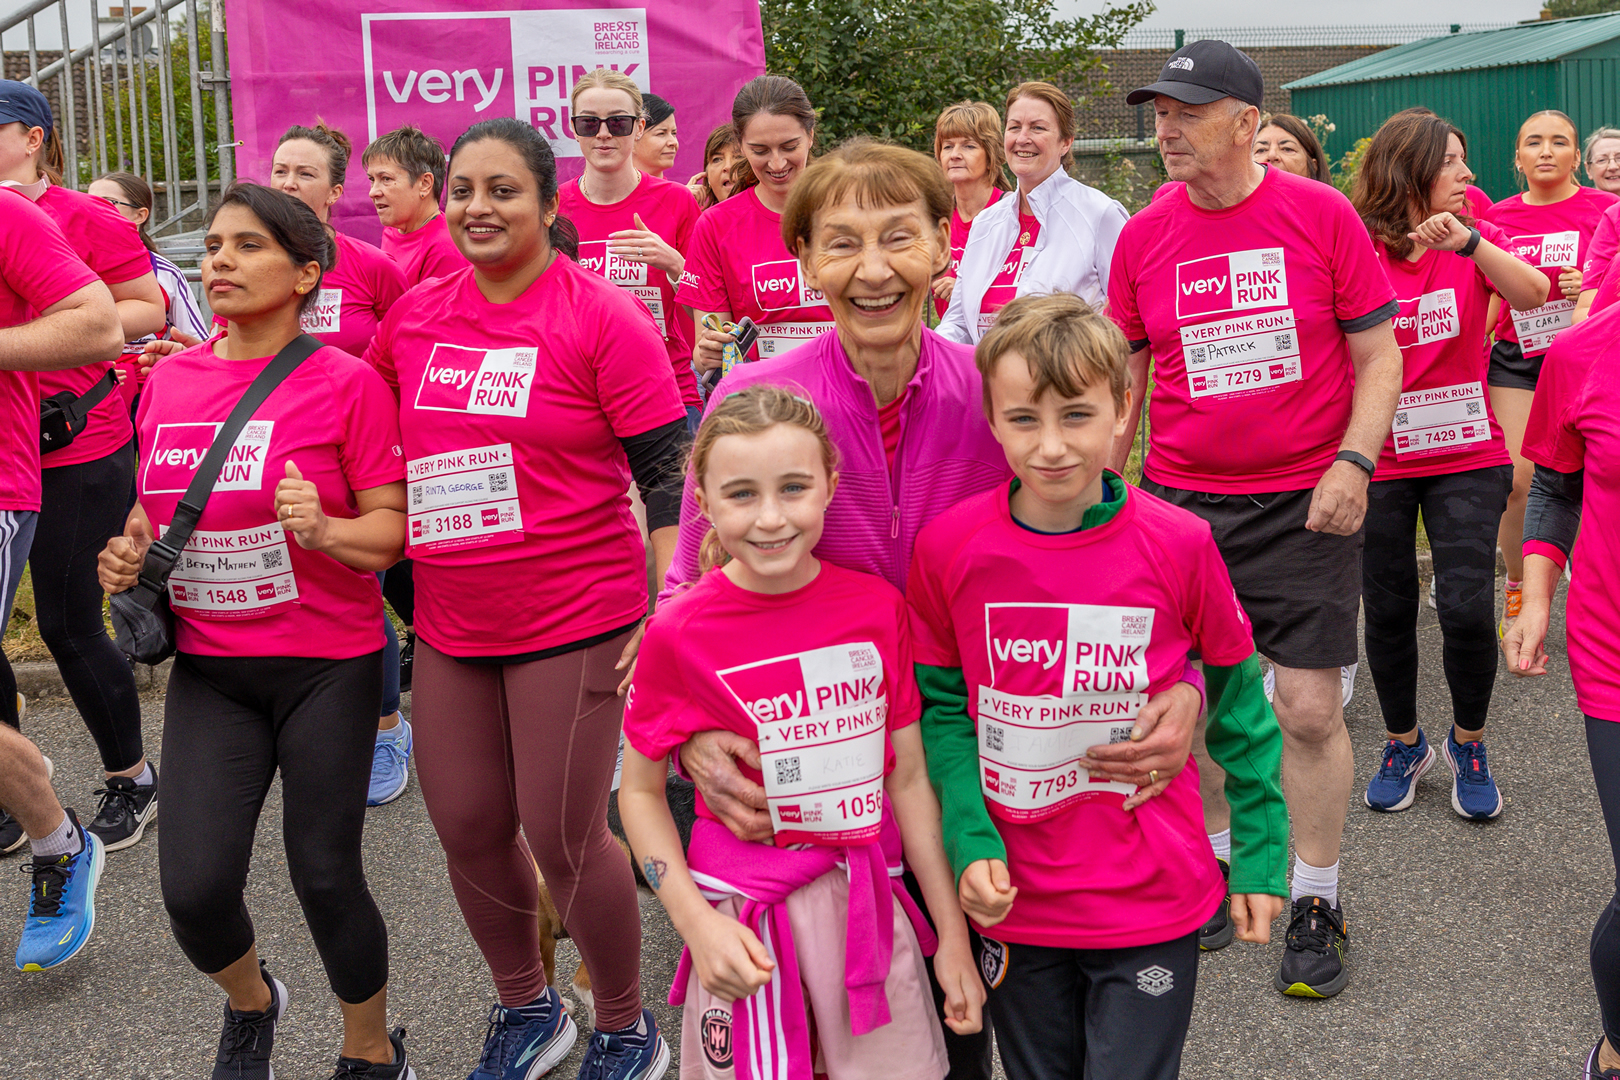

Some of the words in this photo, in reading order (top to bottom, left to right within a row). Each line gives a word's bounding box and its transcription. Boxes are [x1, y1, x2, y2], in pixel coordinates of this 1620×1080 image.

[594, 32, 639, 41] CANCER
[595, 41, 639, 50] IRELAND
[382, 68, 504, 112] very
[1545, 243, 1575, 252] PINK
[579, 257, 604, 272] ery
[1544, 253, 1571, 263] RUN
[609, 269, 640, 280] RUN
[1236, 269, 1282, 288] PINK
[634, 289, 655, 297] RUN
[757, 277, 796, 294] very
[1181, 275, 1227, 296] very
[804, 289, 824, 302] RU
[1237, 286, 1278, 304] RUN
[1421, 306, 1454, 325] PINK
[1541, 302, 1560, 313] PINK
[300, 316, 332, 328] RUN
[1192, 326, 1221, 339] VERY
[1225, 321, 1253, 334] PINK
[1256, 316, 1284, 329] RUN
[1422, 320, 1452, 339] RUN
[1535, 315, 1560, 328] CARA
[763, 326, 788, 334] VERY
[790, 326, 813, 335] PINK
[429, 366, 475, 390] very
[479, 372, 529, 389] PINK
[1225, 369, 1262, 386] 7279
[474, 389, 517, 408] RUN
[1398, 395, 1422, 406] VERY
[1425, 391, 1449, 402] PINK
[1451, 387, 1473, 398] RUN
[1425, 430, 1456, 444] 7429
[155, 448, 208, 470] very
[226, 445, 262, 462] NK
[414, 460, 435, 475] VERY
[437, 456, 465, 470] PINK
[469, 450, 499, 465] RUN
[425, 485, 447, 496] RINTA
[448, 483, 484, 493] GEORGE
[435, 513, 473, 533] 3188
[185, 536, 198, 547] RY
[201, 537, 235, 548] PINK
[238, 530, 272, 547] RUN
[173, 589, 186, 597] very
[206, 589, 248, 604] 1548
[257, 587, 274, 596] very
[277, 588, 292, 596] RUN
[1122, 622, 1146, 630] CANCER
[993, 638, 1063, 671] very
[1075, 642, 1143, 667] PINK
[1072, 669, 1135, 693] RUN
[815, 675, 877, 710] PINK
[992, 697, 1034, 721] VERY
[1040, 703, 1084, 721] PINK
[1089, 701, 1129, 716] RUN
[778, 720, 830, 742] VERY
[836, 709, 874, 734] PINK
[1009, 728, 1085, 753] JAMIE
[823, 753, 866, 774] KATIE
[985, 775, 999, 787] very
[1001, 781, 1016, 792] PINK
[1029, 770, 1078, 799] 7793
[1001, 788, 1015, 797] RUN
[780, 810, 800, 819] very
[803, 809, 823, 817] PINK
